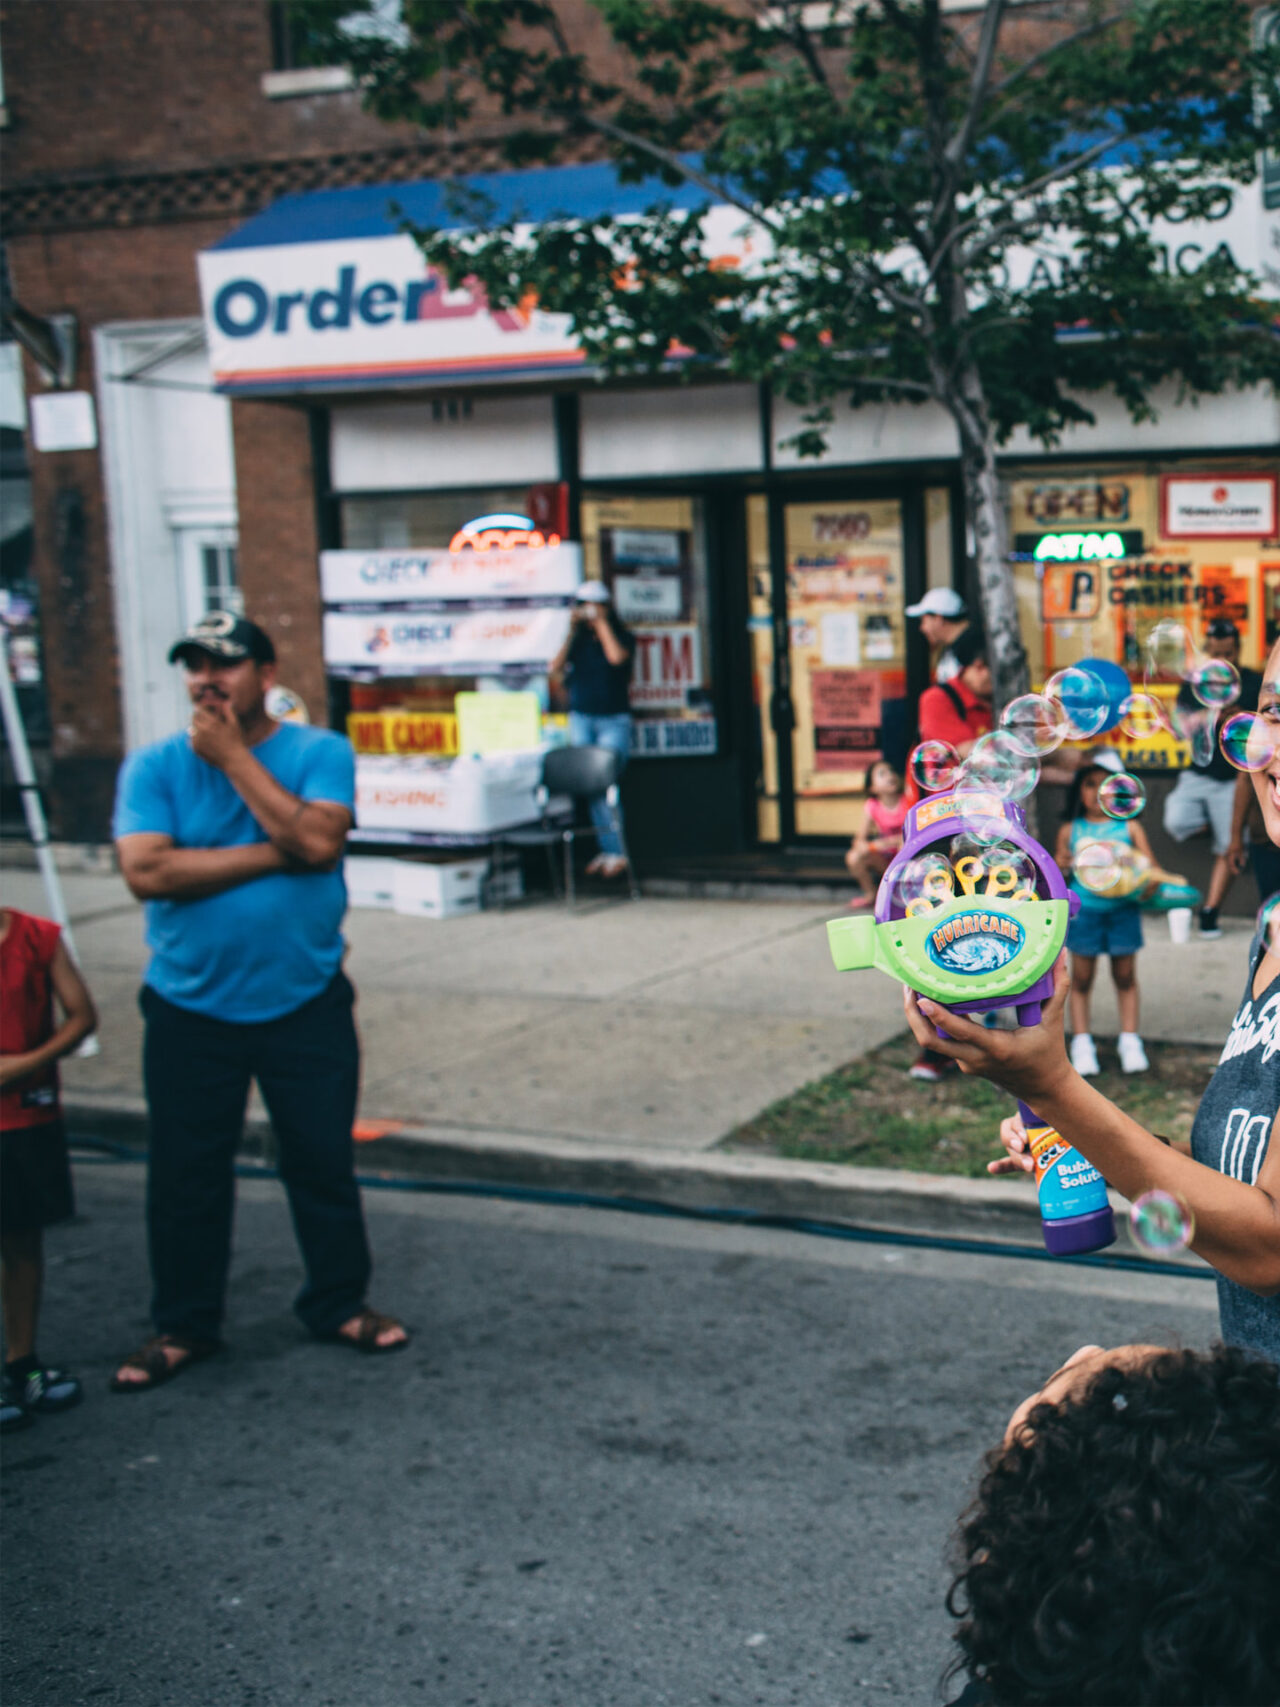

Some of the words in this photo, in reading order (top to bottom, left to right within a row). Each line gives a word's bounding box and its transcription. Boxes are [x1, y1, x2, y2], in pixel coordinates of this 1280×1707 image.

[1034, 532, 1126, 562] ATM
[1108, 561, 1193, 581] CHECK
[1108, 584, 1226, 606] CASHERS
[636, 635, 694, 682] TM
[932, 914, 1020, 953] HURRICANE
